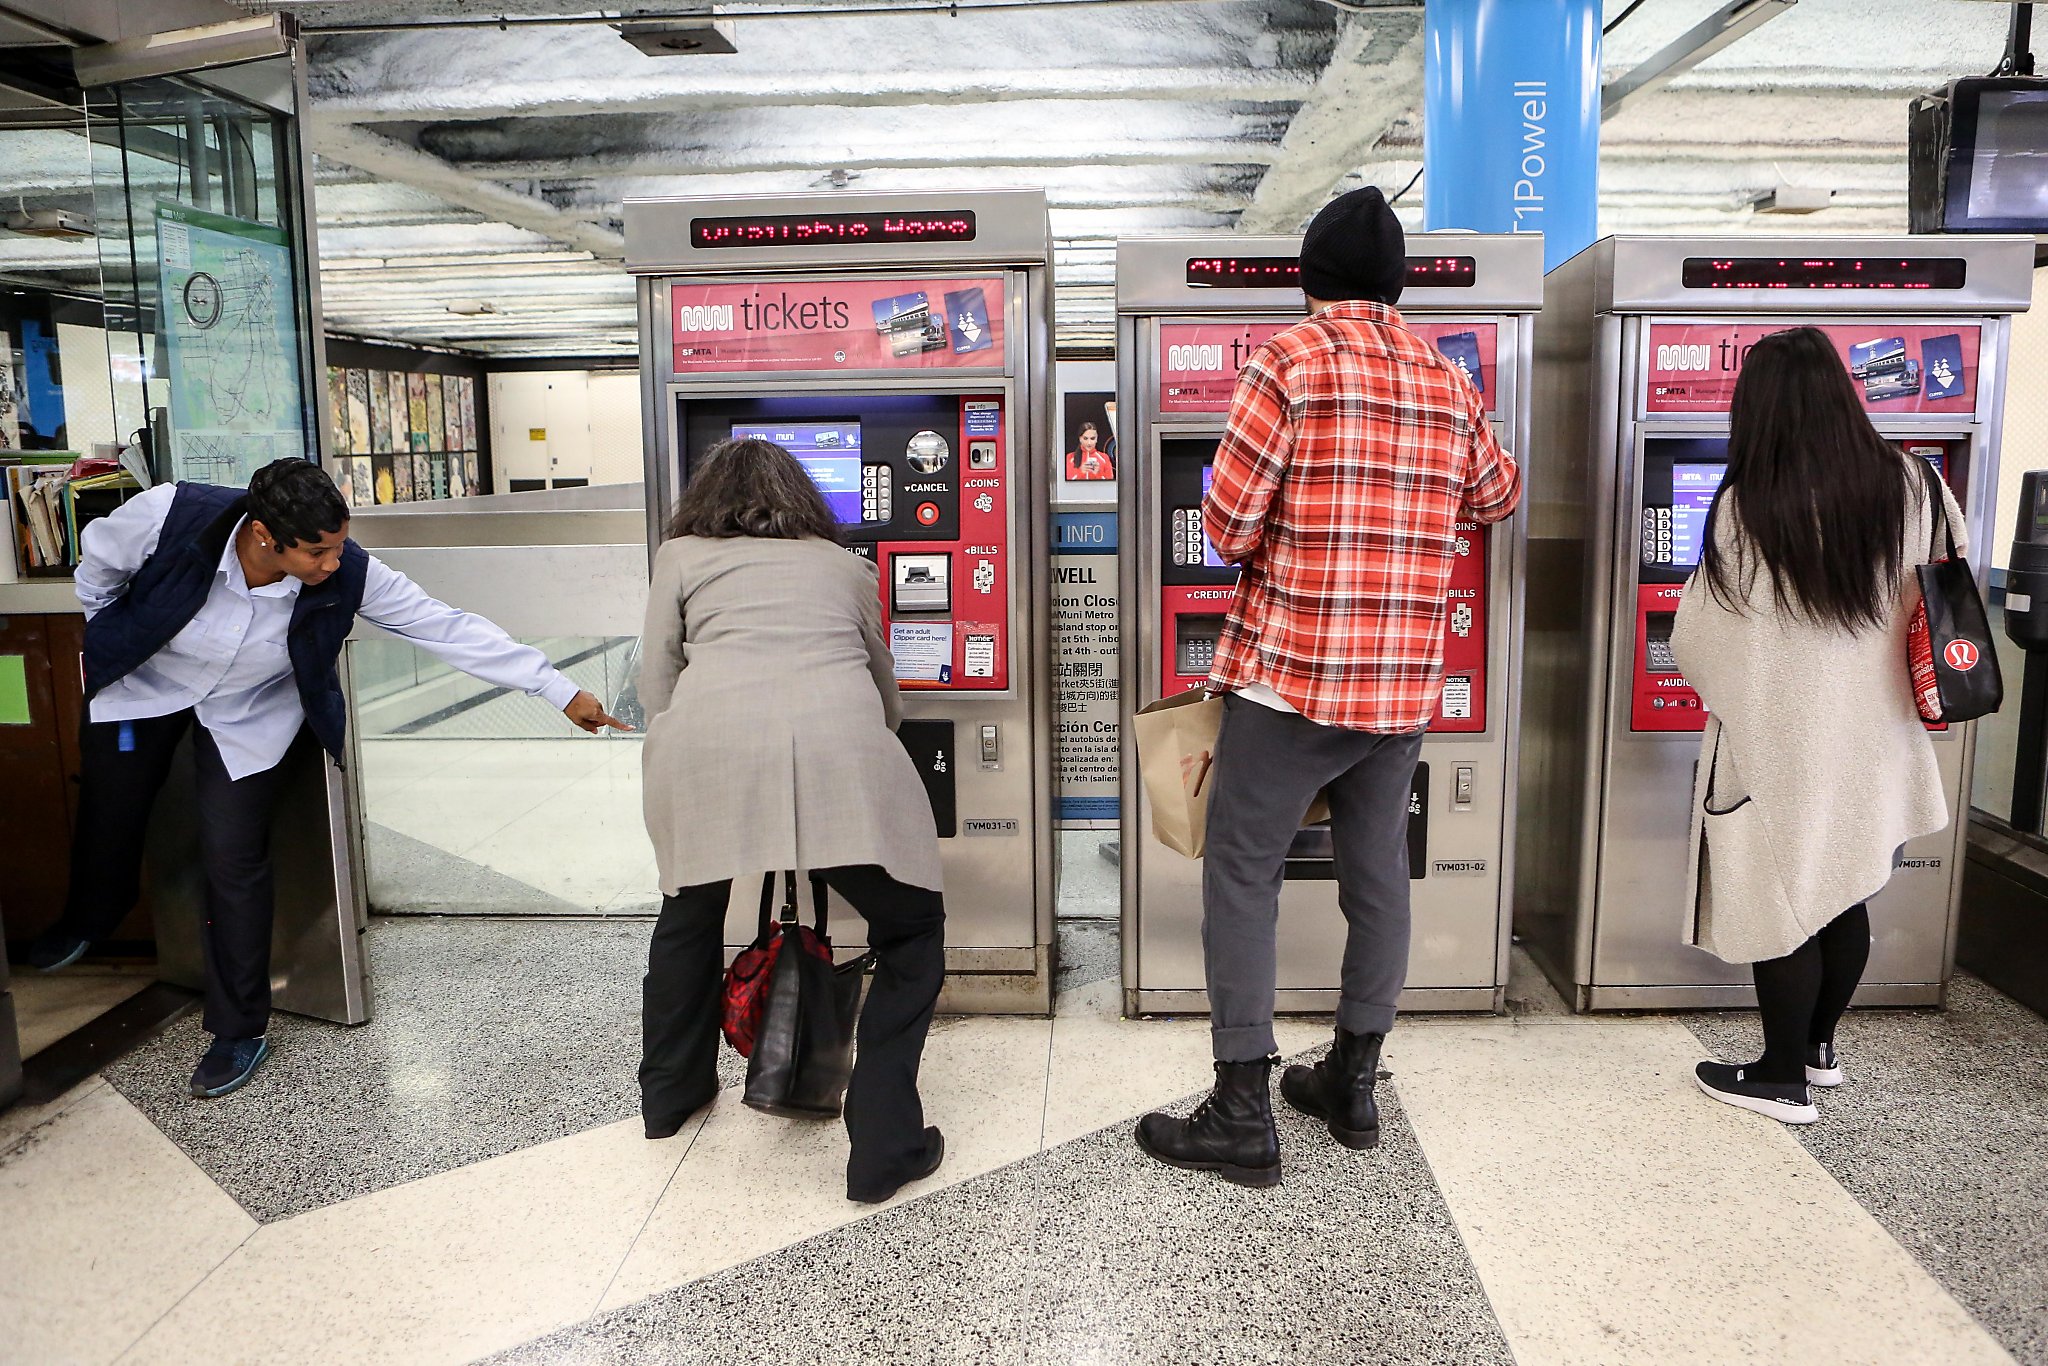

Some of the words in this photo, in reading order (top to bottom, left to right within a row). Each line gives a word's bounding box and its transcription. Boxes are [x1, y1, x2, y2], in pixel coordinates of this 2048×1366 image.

[739, 292, 850, 331] tickets
[682, 348, 712, 356] SFMTA
[1168, 388, 1199, 396] SFMTA
[1655, 387, 1686, 396] SFMTA
[866, 467, 872, 476] F
[866, 478, 873, 487] G
[970, 478, 1000, 488] COINS
[910, 483, 949, 492] CANCEL
[866, 489, 873, 498] H
[866, 511, 872, 520] J
[1191, 511, 1198, 519] A
[1661, 509, 1667, 518] A
[1192, 522, 1198, 530] B
[1661, 520, 1668, 529] B
[1067, 525, 1104, 543] INFO
[1192, 532, 1198, 541] C
[1661, 531, 1668, 540] C
[970, 545, 998, 555] BILLS
[1192, 543, 1199, 552] D
[1661, 542, 1668, 551] D
[1192, 554, 1198, 563] E
[1661, 552, 1668, 561] E
[1448, 589, 1476, 598] BILLS
[1085, 610, 1114, 619] Metro
[1085, 623, 1107, 632] stop
[893, 634, 915, 642] Clipper
[1061, 635, 1071, 643] at
[1073, 634, 1090, 643] 5th
[1062, 647, 1072, 655] at
[1074, 647, 1091, 655] 4th
[1069, 735, 1104, 743] autobús
[1084, 745, 1092, 753] la
[1094, 745, 1109, 753] isla
[1069, 765, 1077, 773] el
[1079, 765, 1105, 773] centro
[1073, 775, 1088, 783] 4th
[966, 821, 1016, 830] TVM031-01
[1435, 863, 1486, 871] TVM031-02
